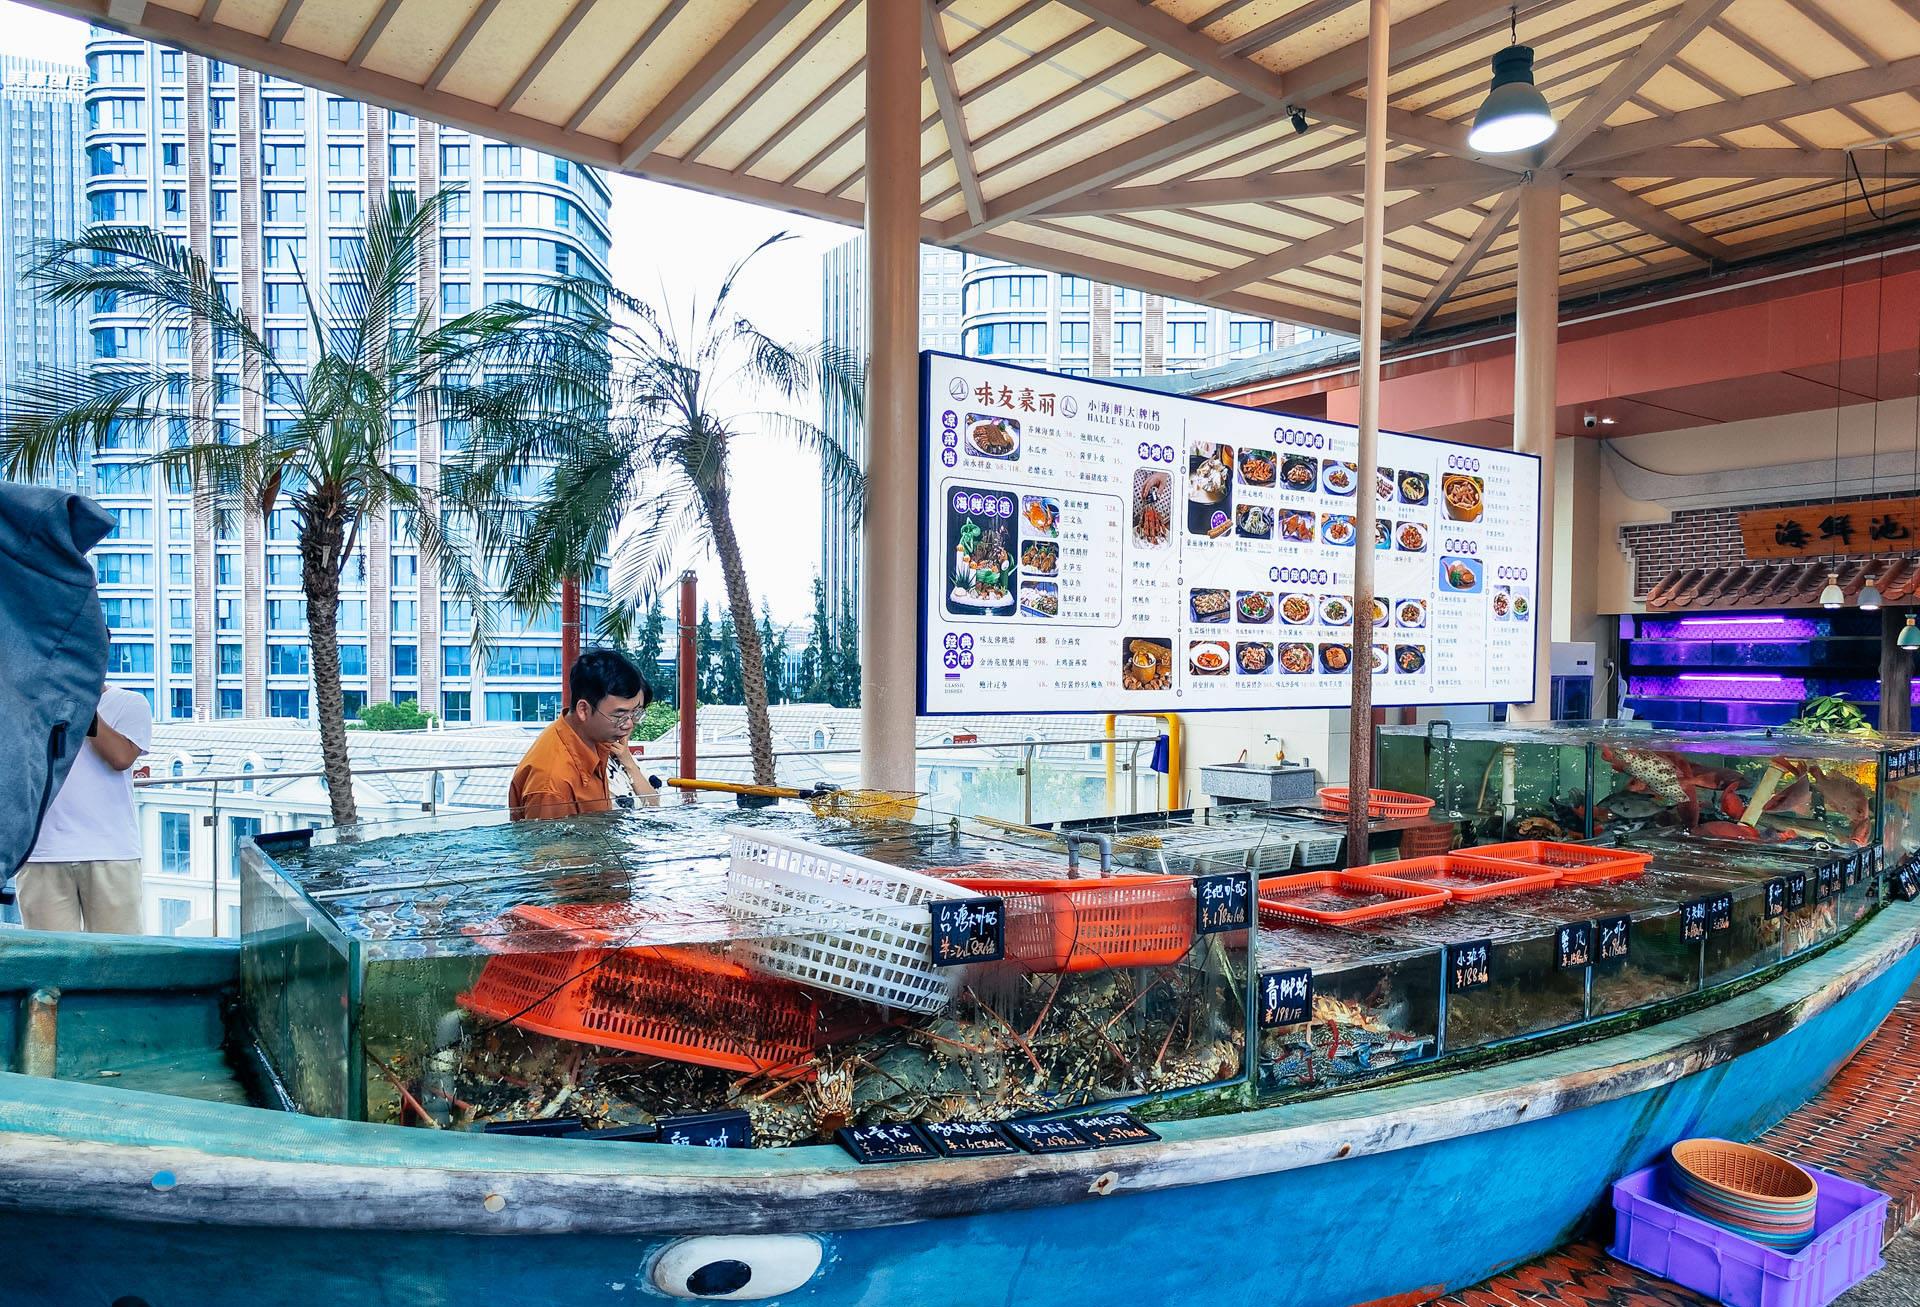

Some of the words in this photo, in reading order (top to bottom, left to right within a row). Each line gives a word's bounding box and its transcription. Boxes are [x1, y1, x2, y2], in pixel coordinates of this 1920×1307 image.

[974, 381, 1057, 416] 味友豪丽
[1087, 413, 1117, 425] HALLE
[1119, 417, 1136, 429] SEA
[1138, 421, 1160, 432] FOOD
[942, 410, 958, 467] 凉菜档
[1064, 516, 1083, 525] 三文鱼
[1774, 514, 1911, 548] 海鲜池
[944, 632, 974, 650] 经典
[944, 650, 974, 669] 大菜
